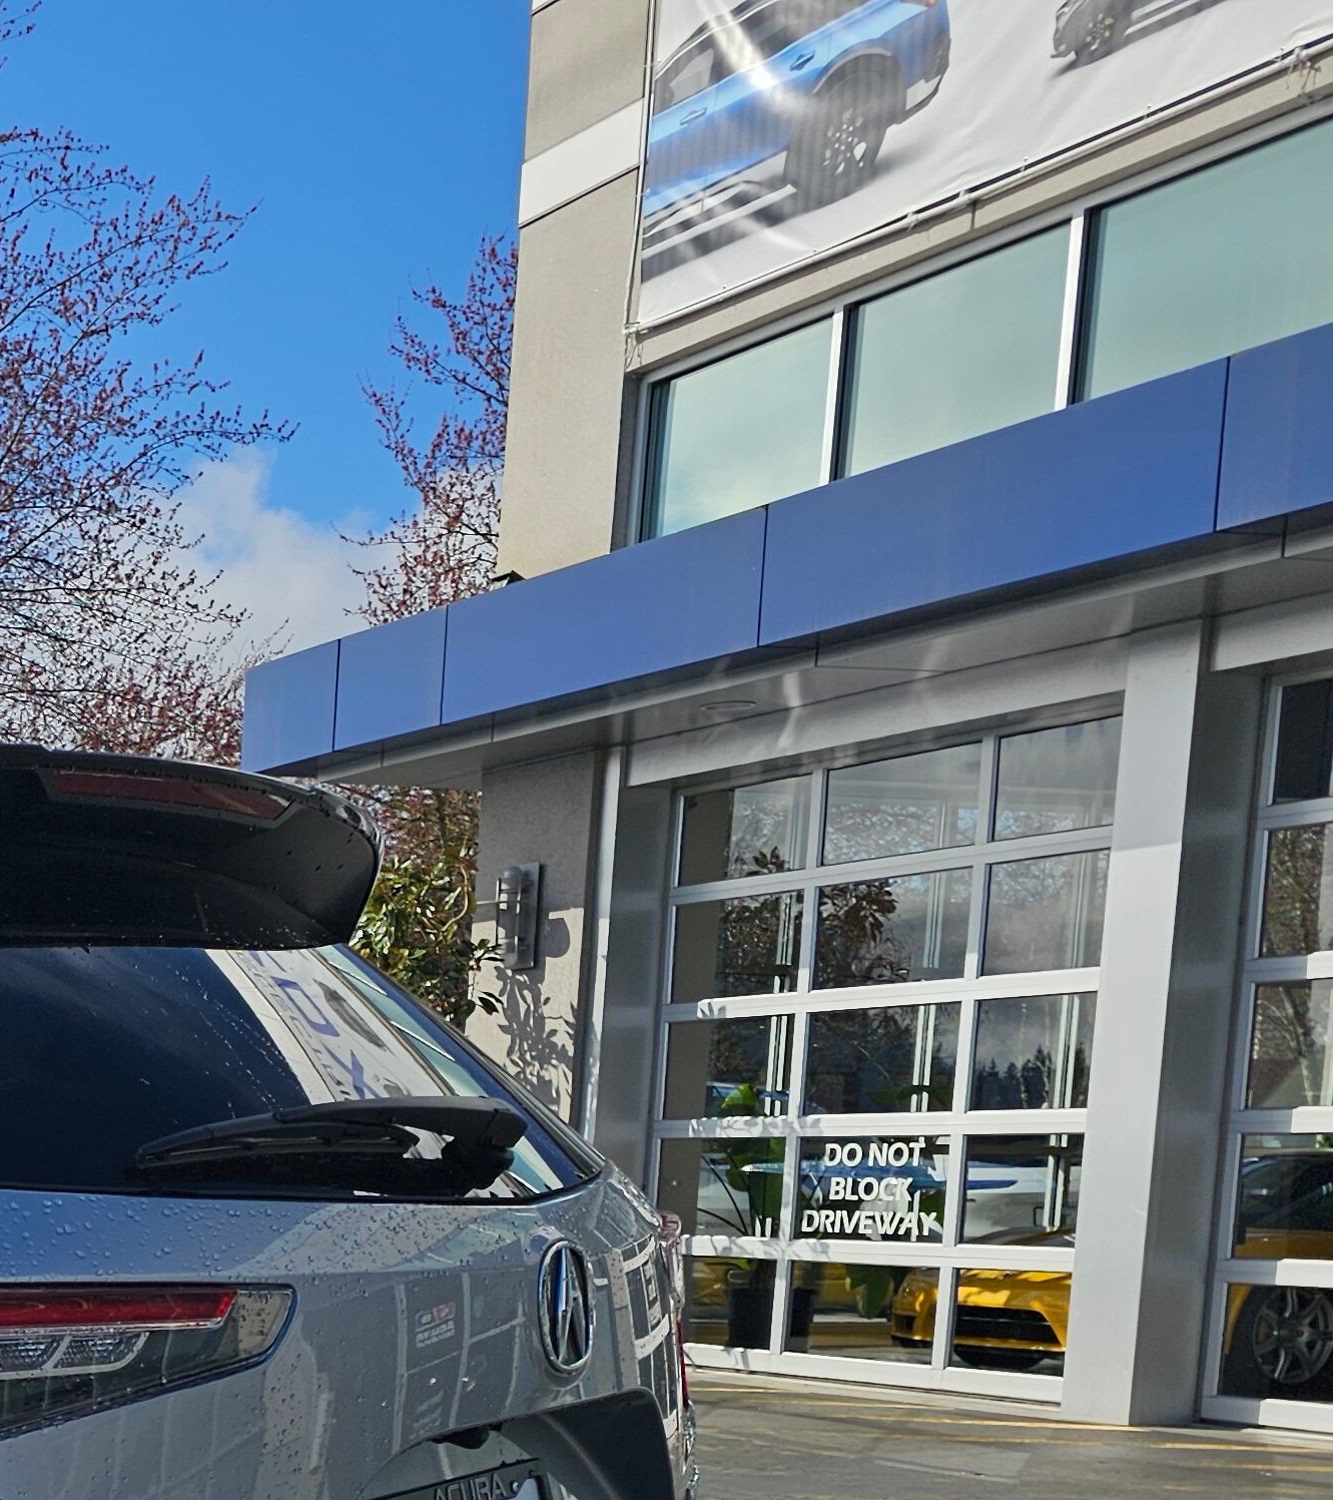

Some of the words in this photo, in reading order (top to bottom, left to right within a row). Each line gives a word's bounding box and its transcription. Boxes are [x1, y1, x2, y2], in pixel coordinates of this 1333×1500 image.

[824, 1143, 863, 1167] DO
[868, 1141, 926, 1167] NOT
[829, 1177, 913, 1201] BLOCK
[801, 1209, 937, 1236] DRIVEWAY
